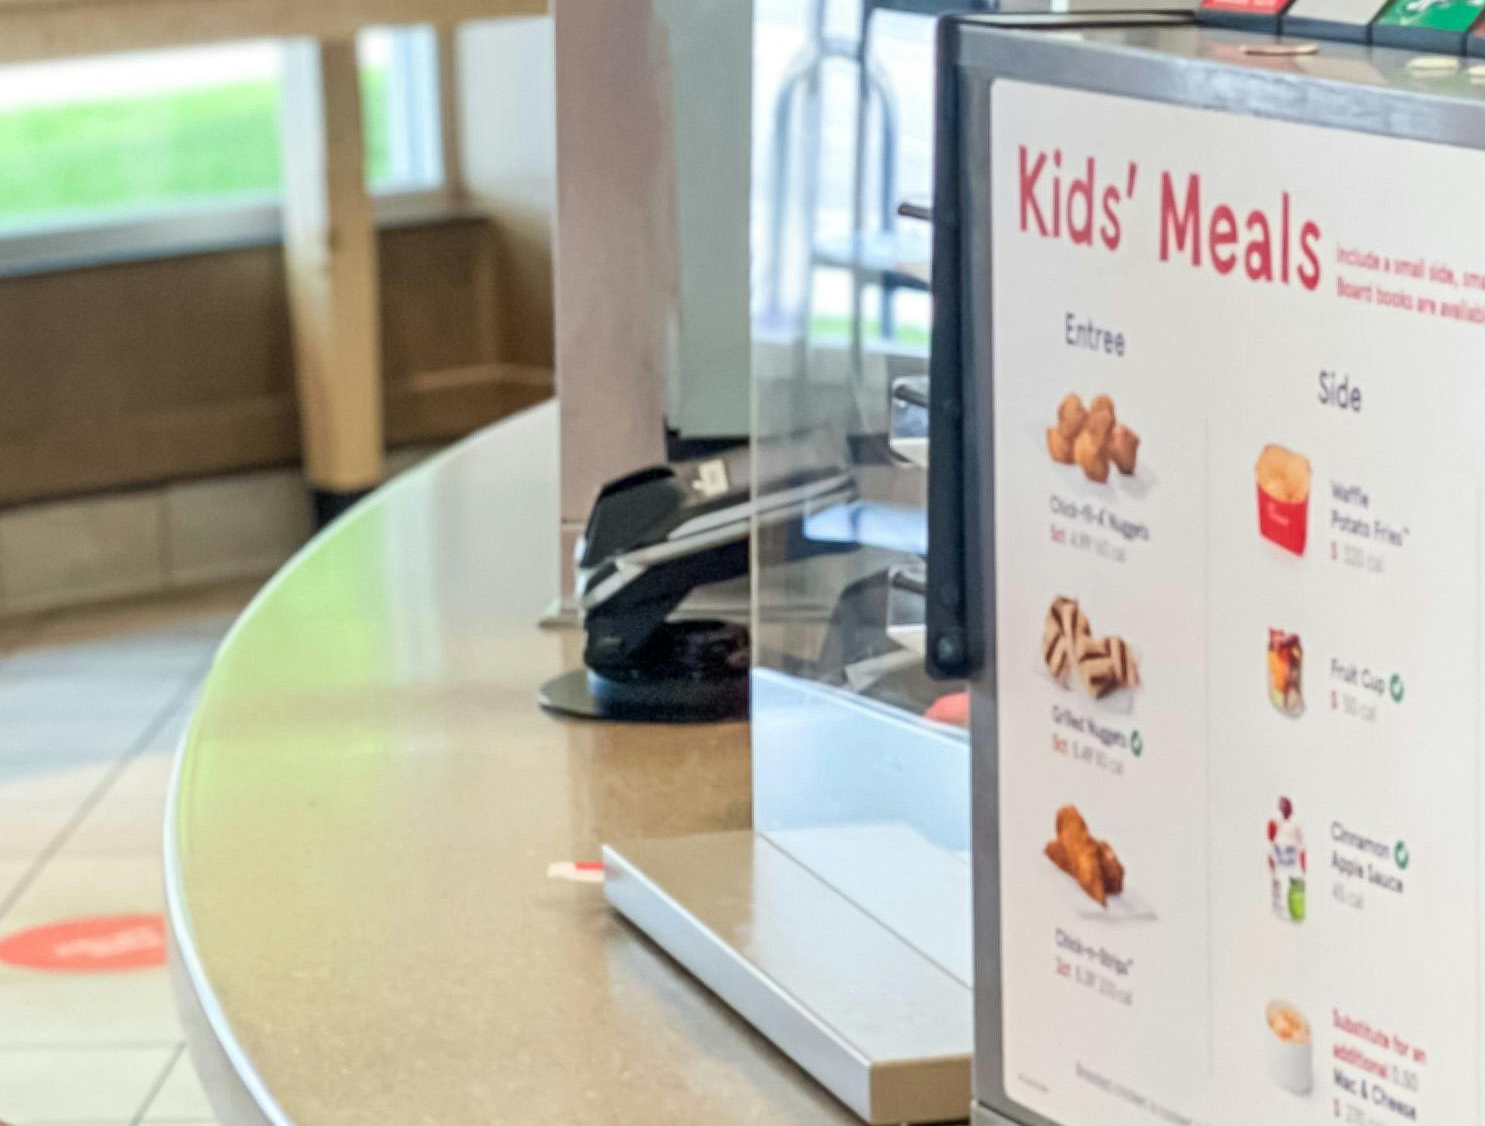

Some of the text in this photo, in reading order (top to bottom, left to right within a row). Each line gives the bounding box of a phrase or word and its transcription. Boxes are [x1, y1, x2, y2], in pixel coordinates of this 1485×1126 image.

[1018, 145, 1322, 292] Kids' Meals
[1336, 243, 1380, 270] Include
[1394, 259, 1425, 278] small
[1336, 274, 1372, 302] Board
[1376, 286, 1412, 310] books
[1417, 297, 1436, 314] are
[1064, 312, 1126, 356] Entree
[1318, 370, 1363, 413] Side
[1331, 480, 1370, 508] Waffle
[1331, 509, 1370, 538] Potato
[1331, 657, 1385, 696] Fruit Cup
[1331, 820, 1390, 859] Cinnamon
[1331, 850, 1363, 878] Apple
[1368, 863, 1403, 893] Sauce
[1333, 1007, 1389, 1049] Substitute
[1393, 1035, 1409, 1056] for
[1333, 1068, 1356, 1096] Mac
[1372, 1084, 1416, 1121] Cheese
